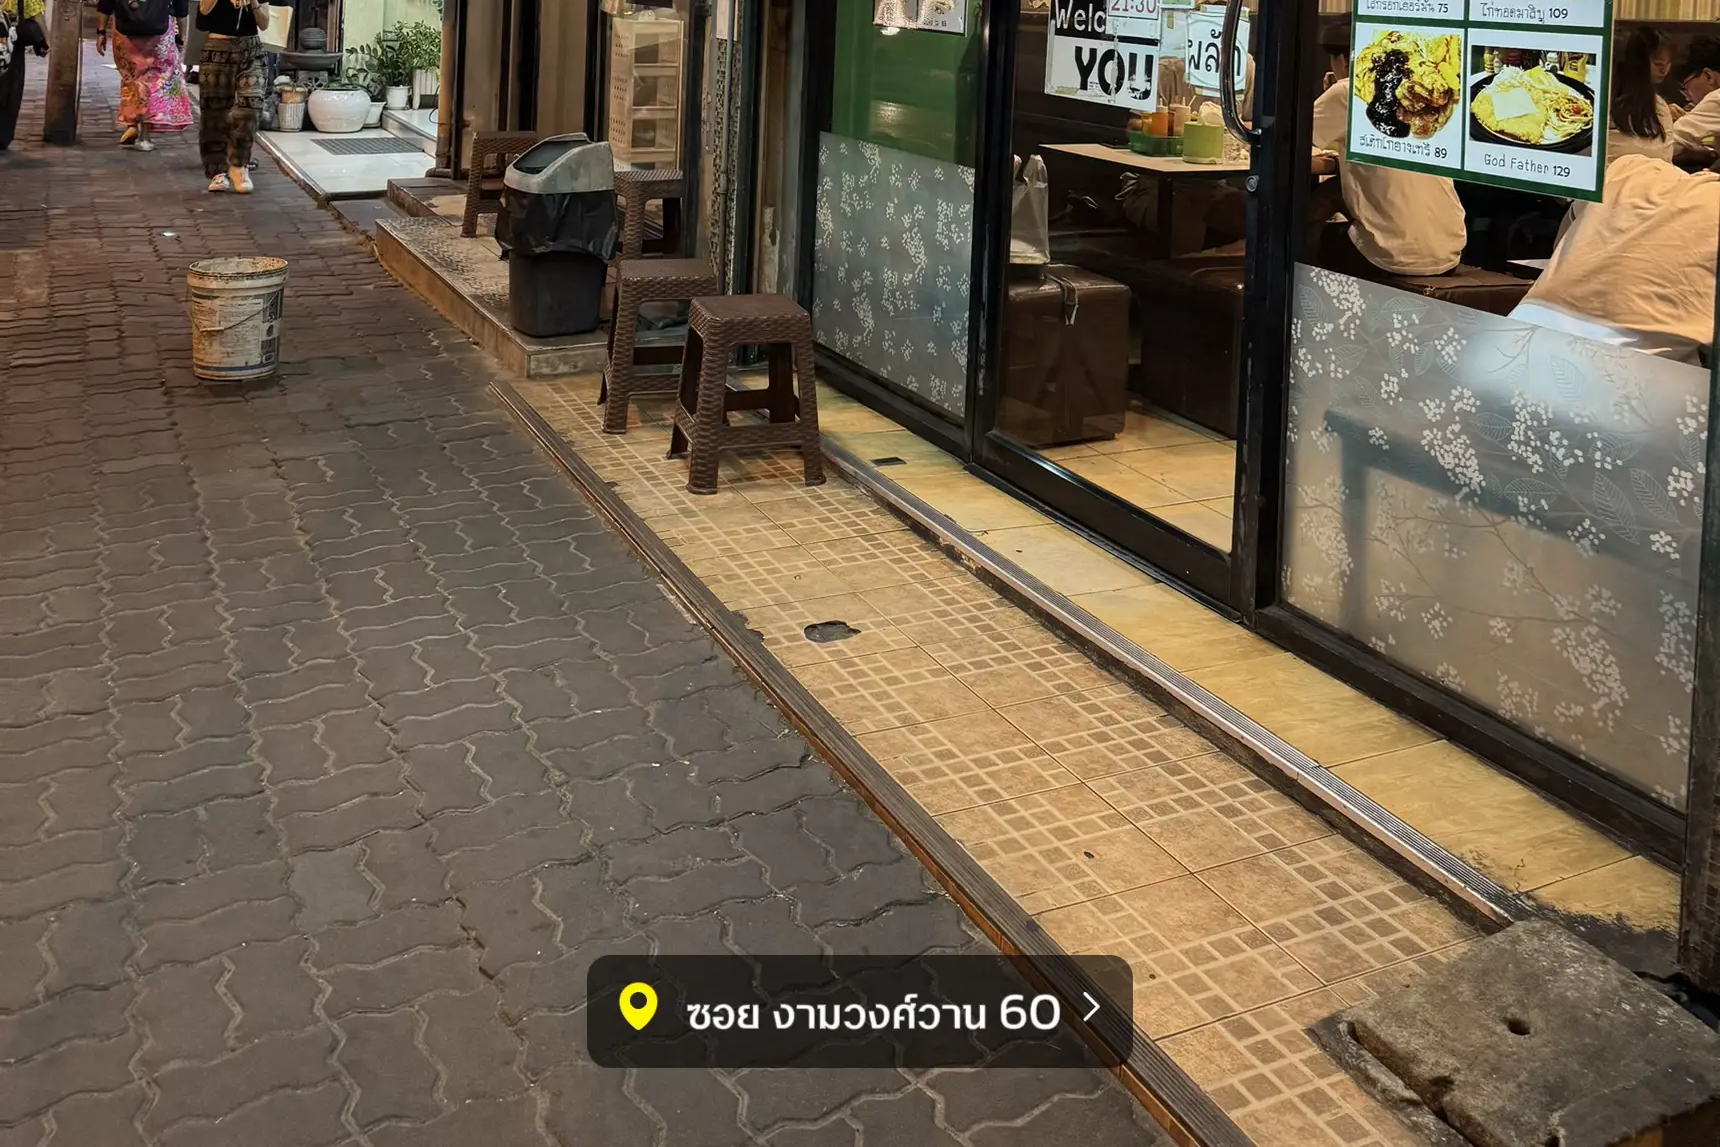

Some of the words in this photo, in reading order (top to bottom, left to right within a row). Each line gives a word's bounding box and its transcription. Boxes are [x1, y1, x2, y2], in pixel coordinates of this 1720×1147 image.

[1437, 3, 1449, 14] 75
[1548, 7, 1569, 20] 109
[1074, 45, 1155, 101] YOU
[1434, 146, 1448, 159] 89
[1484, 153, 1506, 168] God
[1510, 157, 1549, 175] Father
[1552, 165, 1571, 178] 129
